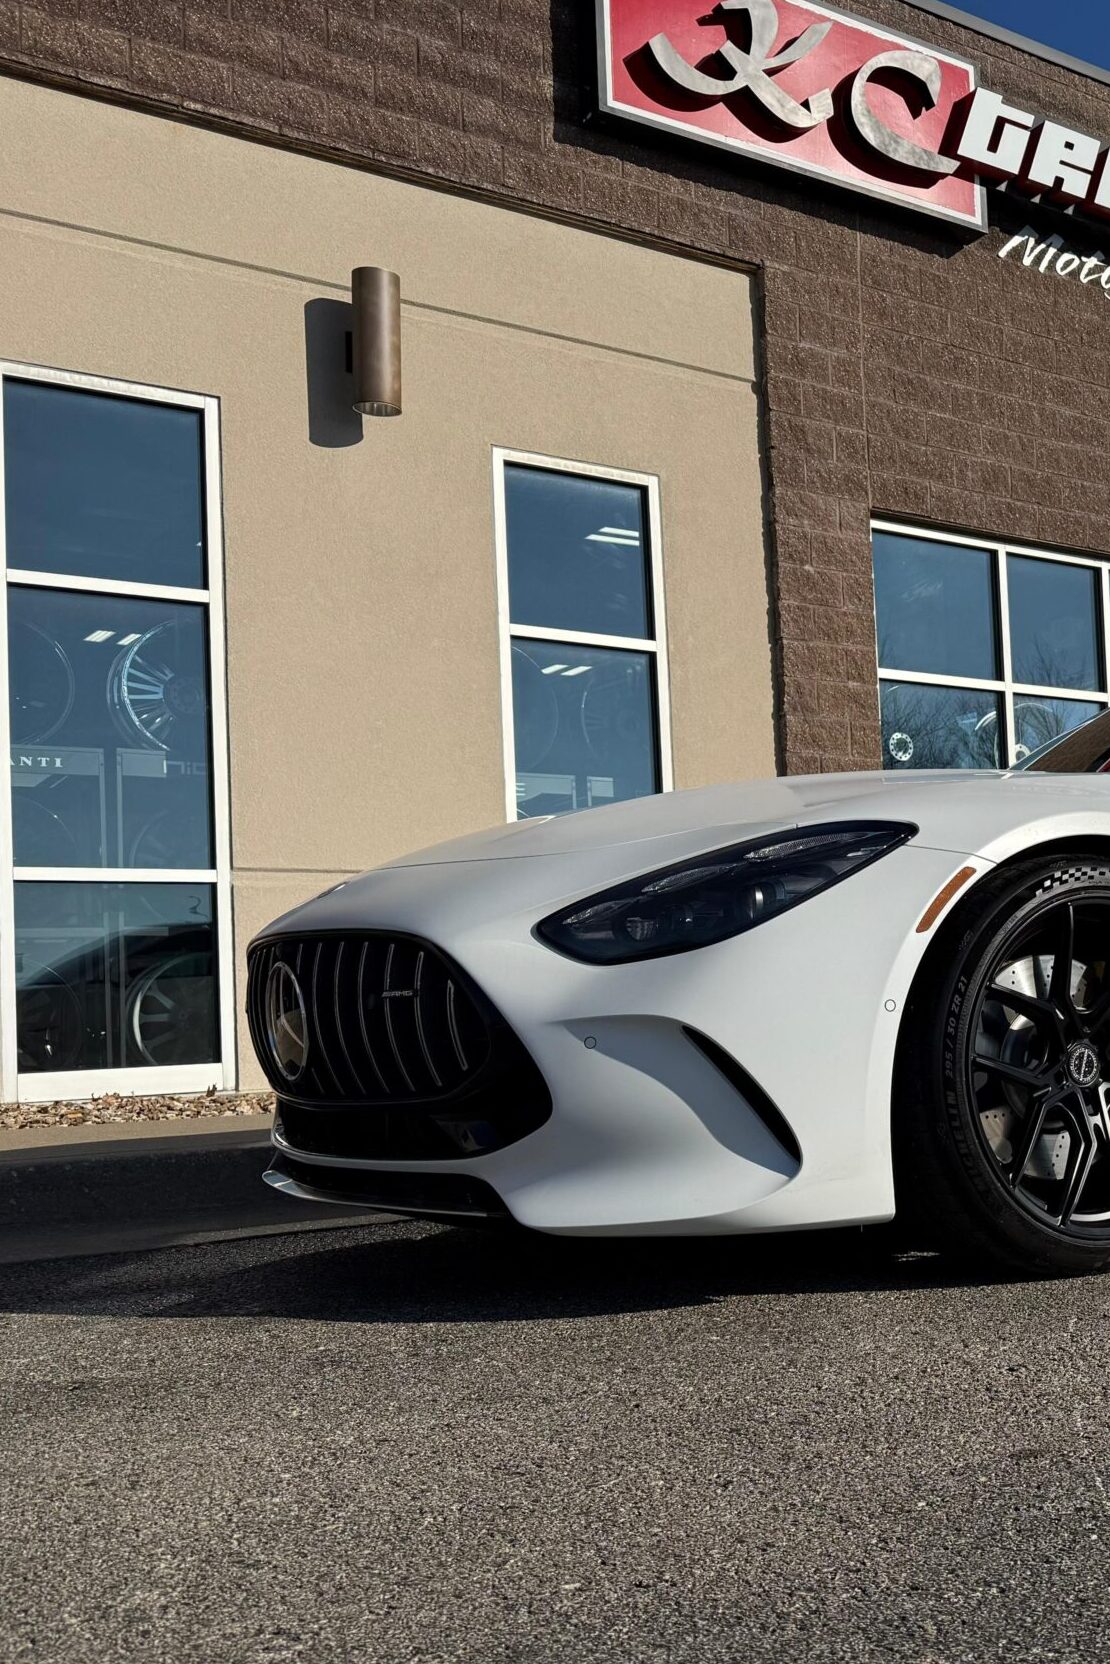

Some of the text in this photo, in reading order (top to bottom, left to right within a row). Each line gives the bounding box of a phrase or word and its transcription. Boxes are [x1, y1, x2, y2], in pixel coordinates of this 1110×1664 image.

[957, 975, 968, 992] 21
[951, 996, 963, 1016] ZR
[946, 1017, 957, 1036] 30
[944, 1052, 954, 1079] 295
[945, 1088, 986, 1194] MICHELIN
